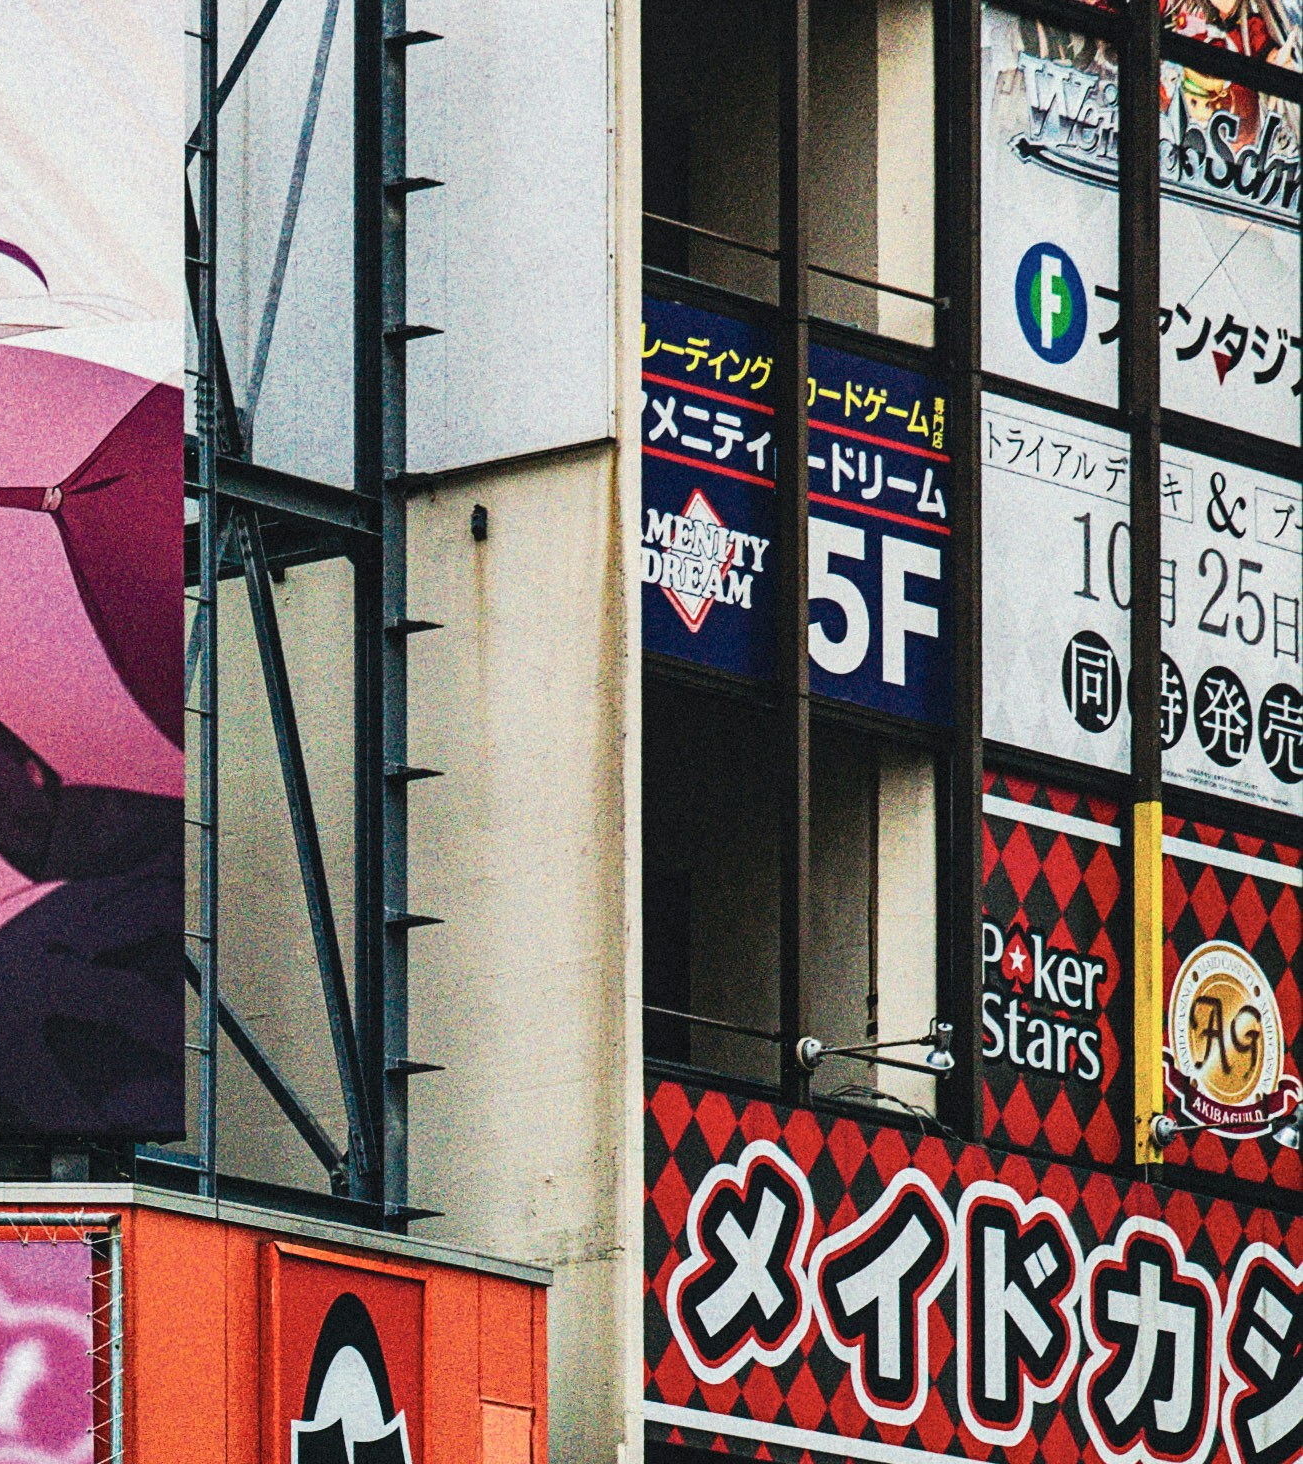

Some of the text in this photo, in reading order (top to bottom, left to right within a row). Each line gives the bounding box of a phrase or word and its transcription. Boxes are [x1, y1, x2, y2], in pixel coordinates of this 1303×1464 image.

[642, 390, 772, 472] メニティ
[642, 548, 754, 610] DREAM
[808, 517, 941, 687] 5F
[982, 989, 1102, 1082] Stars
